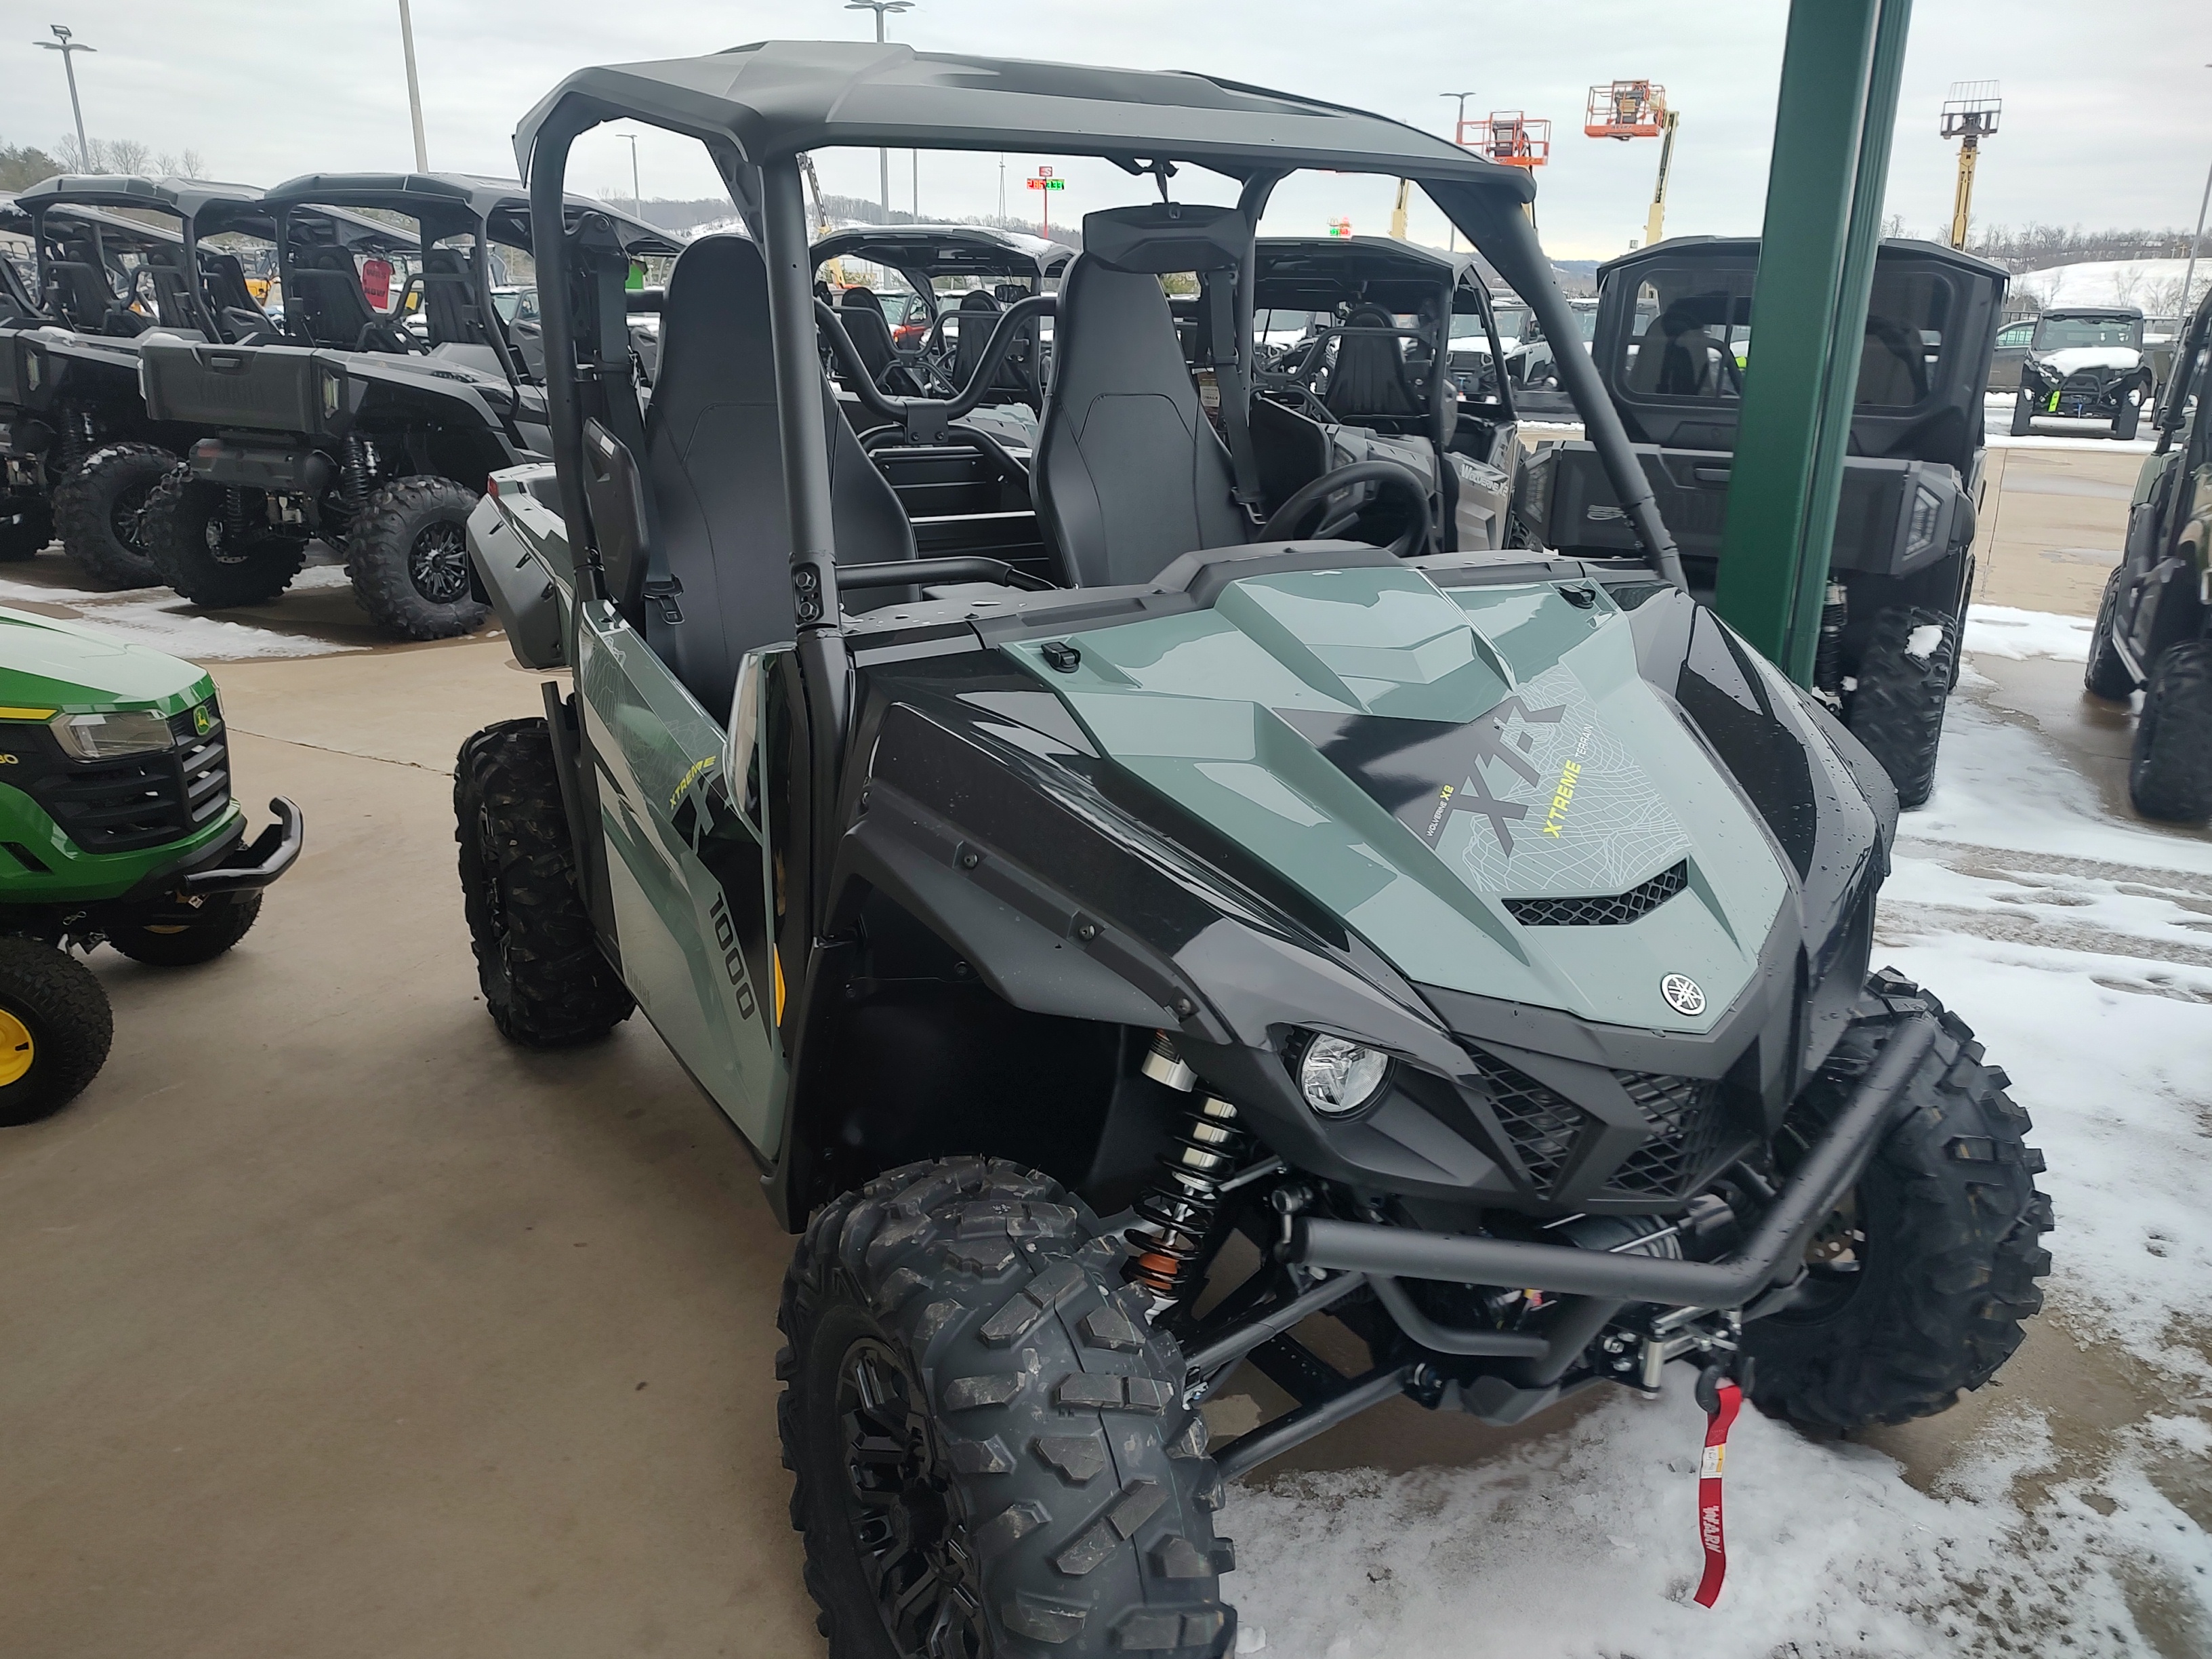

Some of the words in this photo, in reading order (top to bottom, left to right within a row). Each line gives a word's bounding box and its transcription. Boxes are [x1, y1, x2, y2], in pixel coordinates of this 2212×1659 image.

[670, 755, 716, 811] XTREME
[1543, 760, 1582, 839] XTREME
[1574, 724, 1594, 759] TERRAIN
[1426, 800, 1448, 837] WOLVERINE
[710, 891, 756, 1021] 1000
[1702, 1505, 1722, 1554] WARN
